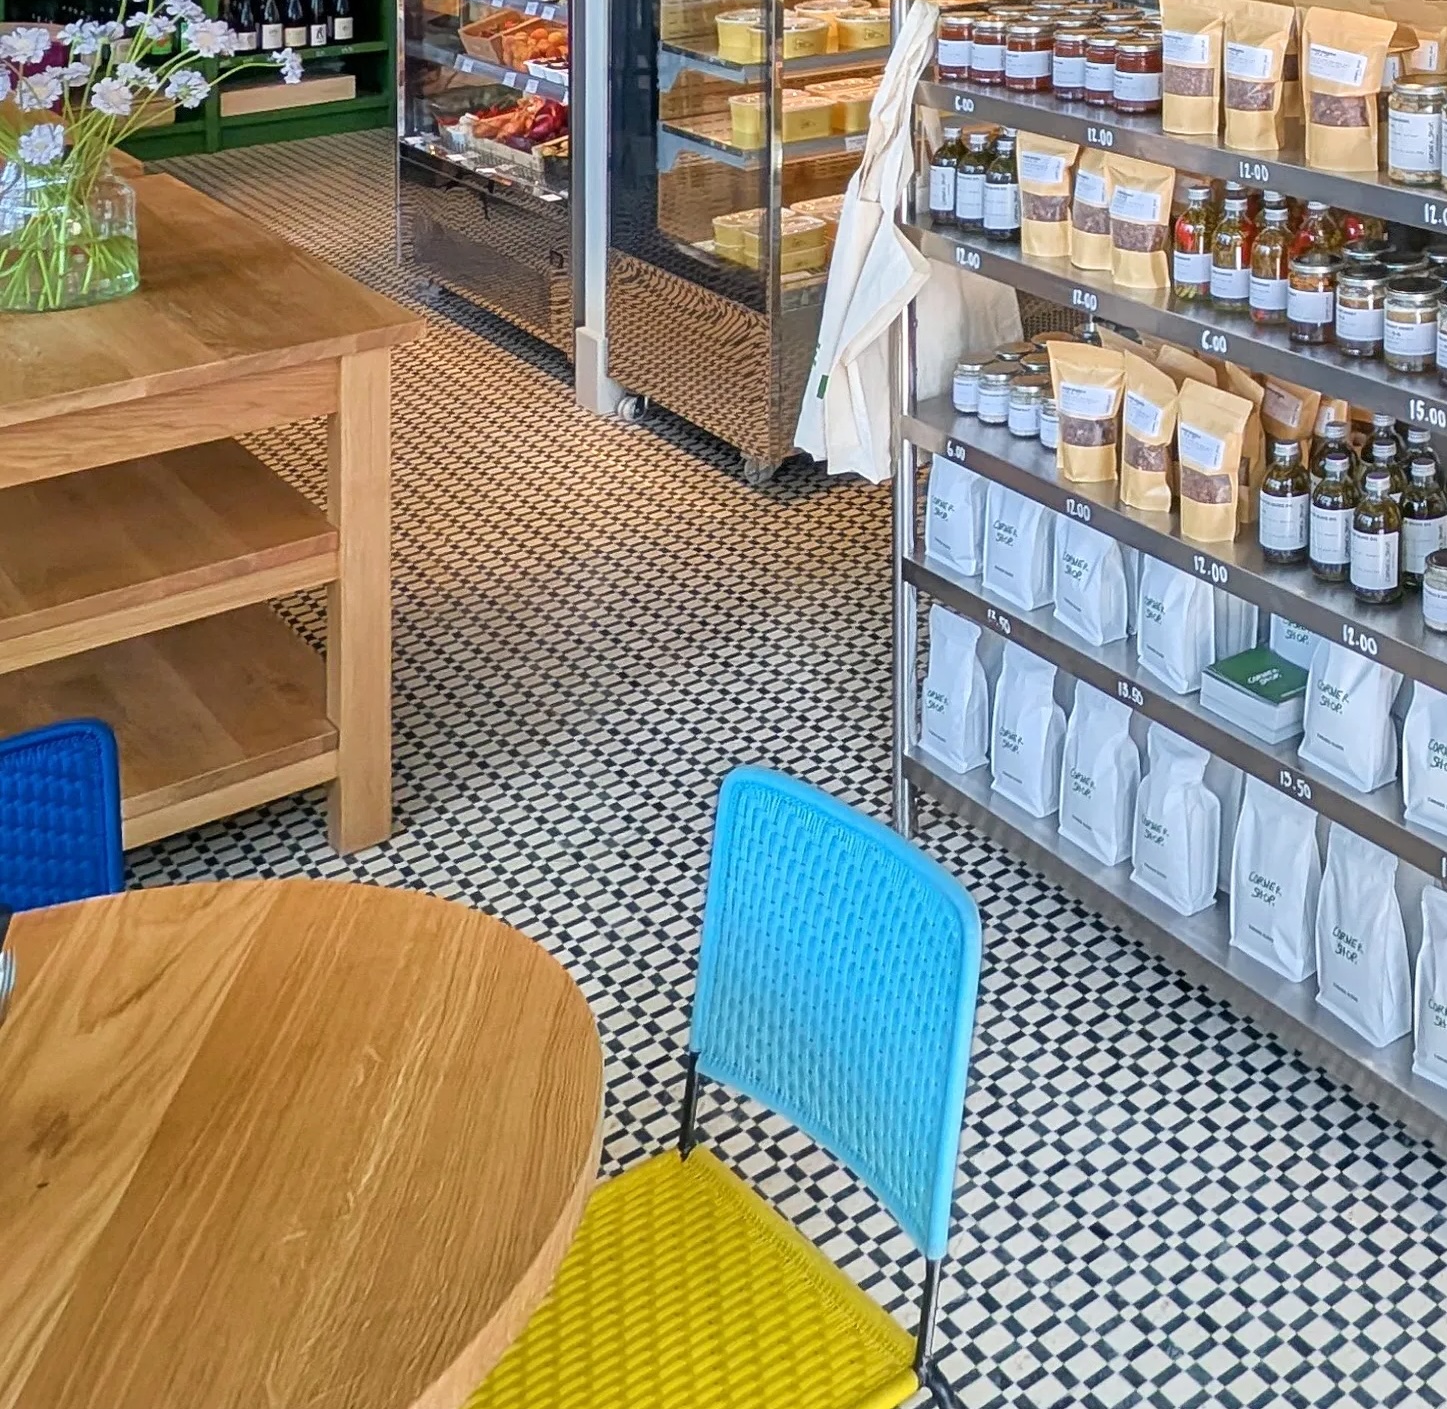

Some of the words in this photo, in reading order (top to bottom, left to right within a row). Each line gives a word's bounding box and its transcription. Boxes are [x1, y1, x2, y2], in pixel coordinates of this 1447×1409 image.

[1087, 127, 1113, 147] 12.00
[1239, 161, 1269, 182] 12.00
[956, 247, 980, 269] 12.00
[1073, 289, 1097, 311] 12.00
[1201, 330, 1228, 353] 6.00
[1409, 399, 1446, 428] 15.00
[947, 440, 966, 461] 6.00
[1066, 498, 1091, 521] 12.00
[1194, 555, 1228, 583] 12.00
[1342, 624, 1378, 655] 12.00
[1317, 679, 1350, 704] CORNER
[1279, 770, 1311, 800] 13.50
[1248, 871, 1282, 897] CORNER
[1332, 926, 1364, 954] CORNER
